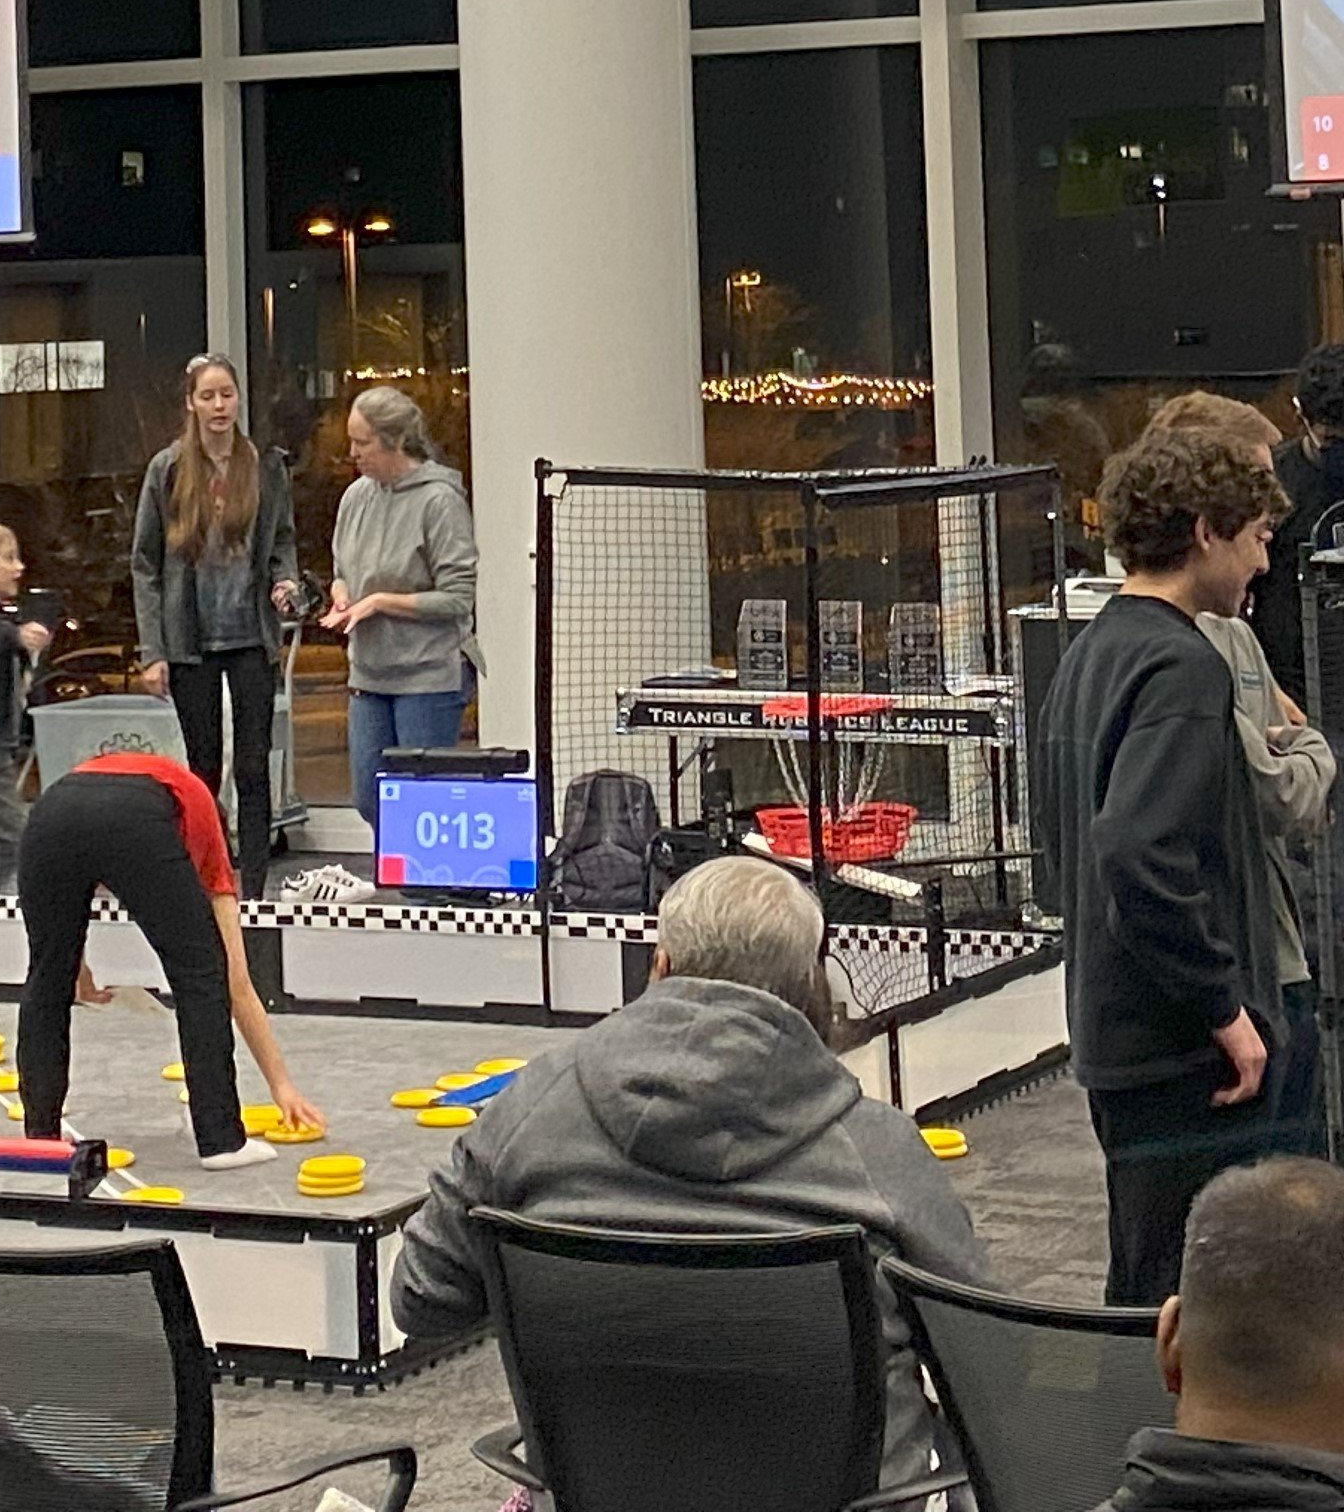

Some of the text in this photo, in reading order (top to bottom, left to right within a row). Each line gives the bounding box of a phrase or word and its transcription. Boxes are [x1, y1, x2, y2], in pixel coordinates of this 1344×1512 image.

[1313, 115, 1333, 132] 10
[1318, 153, 1329, 171] 8
[648, 707, 752, 725] TRIANGLE
[881, 712, 969, 732] LEAGUE
[416, 811, 495, 850] 0:13
